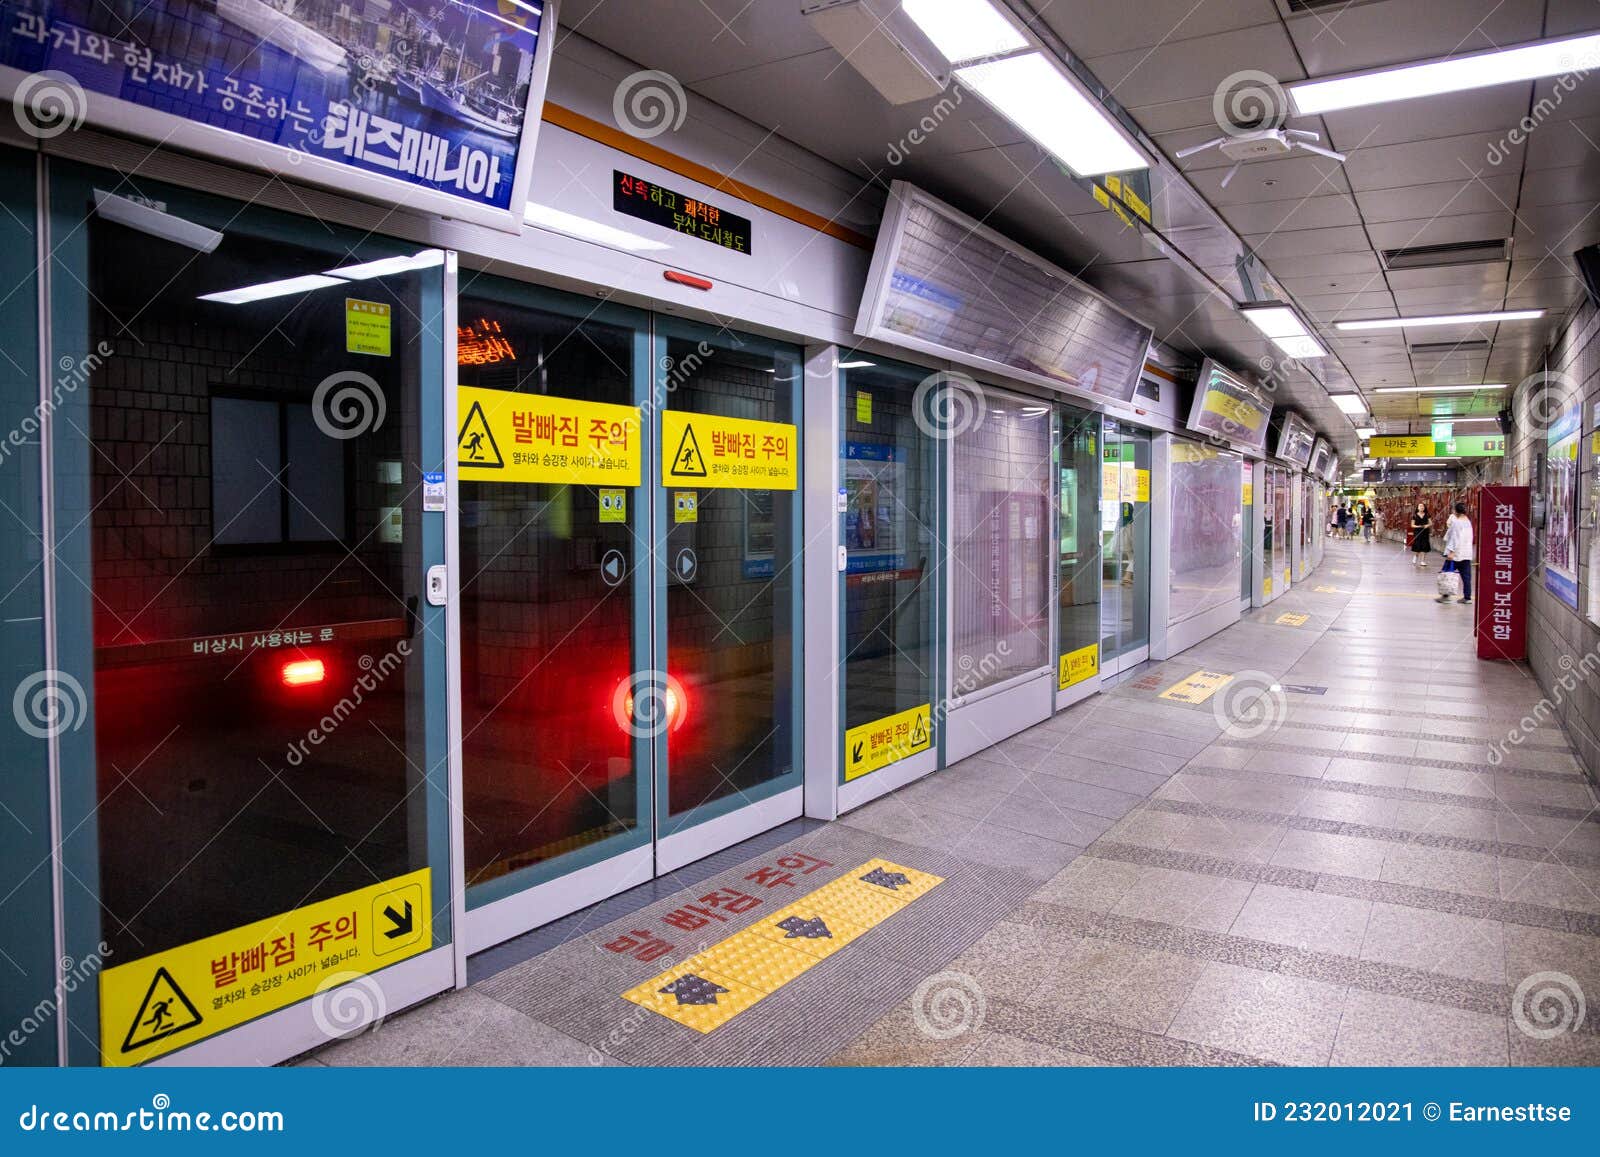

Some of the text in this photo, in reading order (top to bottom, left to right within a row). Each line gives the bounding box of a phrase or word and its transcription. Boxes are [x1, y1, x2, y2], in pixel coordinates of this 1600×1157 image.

[12, 12, 314, 134] 과거와 현재가 공존하는
[323, 100, 500, 199] 태즈매니아
[621, 173, 720, 226] 신속하고 쾌적한
[673, 212, 744, 252] 부산 도시철도
[512, 411, 628, 451] 발빠짐 주의
[712, 430, 789, 461] 발빠짐 주의
[1384, 439, 1418, 449] 나가는 곳
[512, 451, 539, 465] 열차와
[543, 453, 568, 467] 승강장
[571, 456, 594, 468] 사이가
[711, 463, 730, 474] 열차와
[731, 464, 749, 475] 승강장
[1492, 503, 1514, 640] 화재방독면 보관함
[193, 628, 335, 655] 비상시 사용하는 문
[659, 887, 763, 932] 빠짐
[743, 852, 834, 889] 주의
[209, 911, 357, 989] 발빠짐 주의
[211, 945, 361, 1010] 열차와 승강장 사이가 넓습니다.
